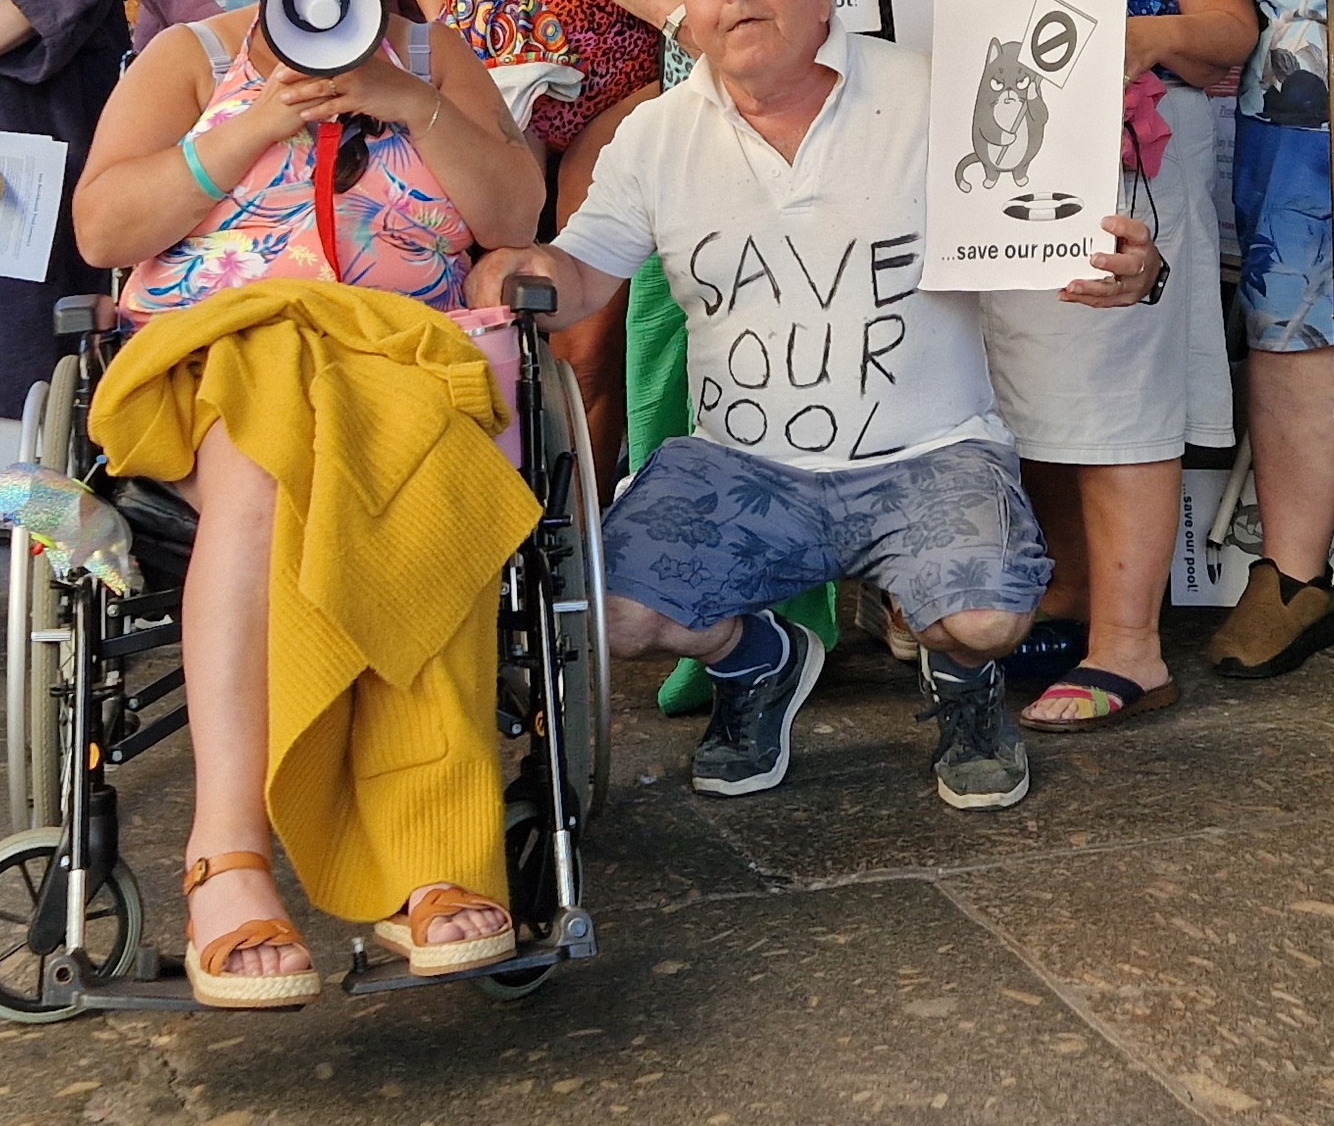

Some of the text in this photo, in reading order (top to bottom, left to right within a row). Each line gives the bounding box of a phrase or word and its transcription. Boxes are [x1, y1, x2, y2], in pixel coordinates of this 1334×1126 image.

[689, 230, 921, 317] SAVE
[941, 237, 1094, 263] ...save our pool!
[727, 314, 907, 400] OUR
[696, 375, 910, 461] POOL
[1182, 484, 1199, 593] ...save our pool!
